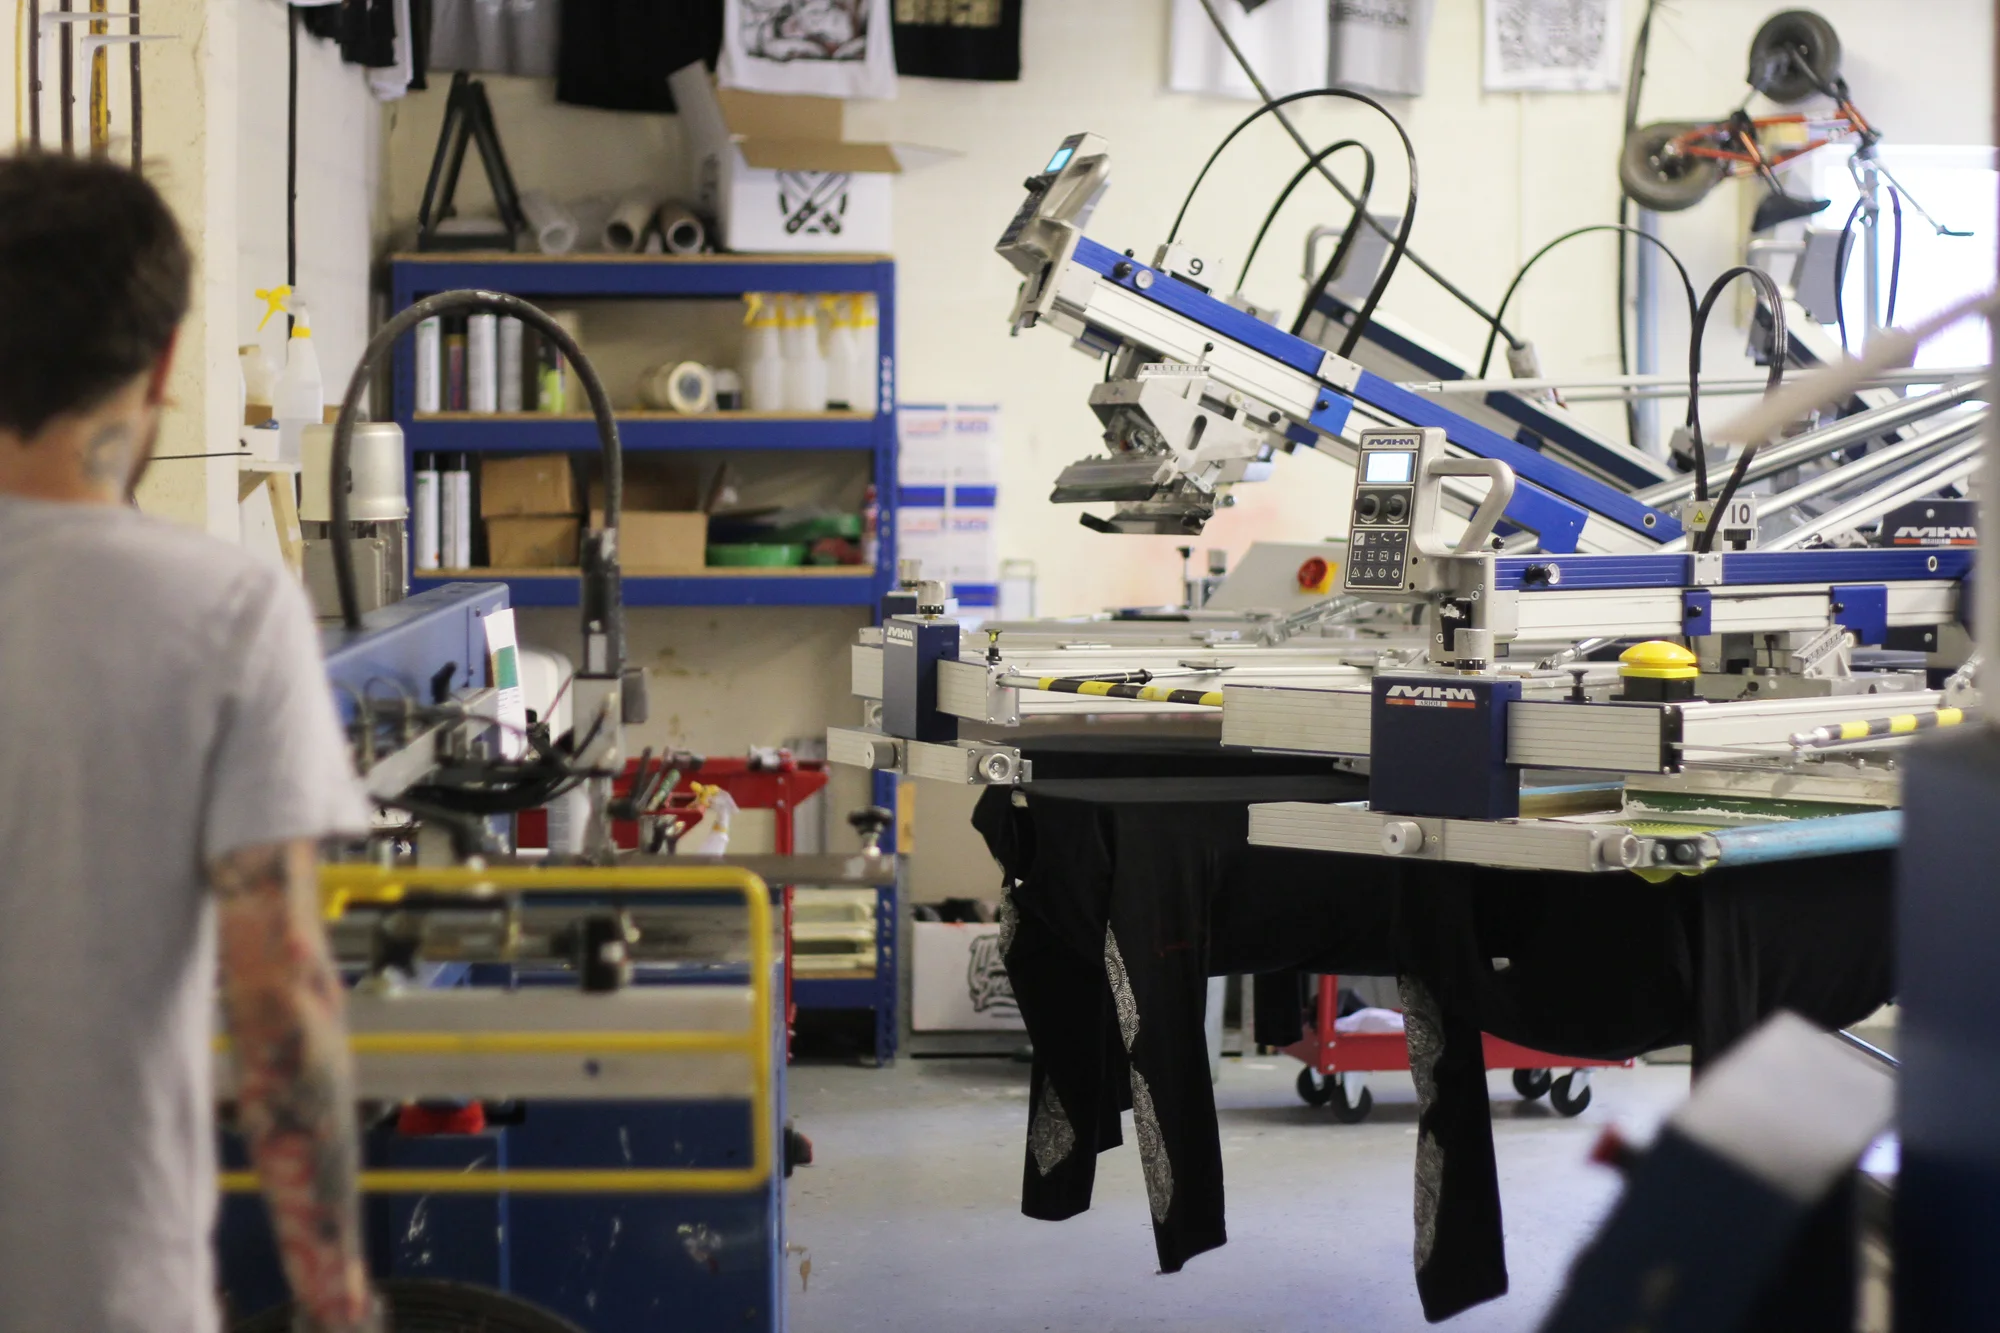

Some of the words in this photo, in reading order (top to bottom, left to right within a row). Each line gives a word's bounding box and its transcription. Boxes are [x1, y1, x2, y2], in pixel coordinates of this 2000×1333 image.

[1187, 257, 1204, 276] 9
[1367, 438, 1415, 446] MHM
[1731, 503, 1751, 524] 10
[1893, 526, 1978, 538] MHM
[1386, 684, 1476, 701] MHM
